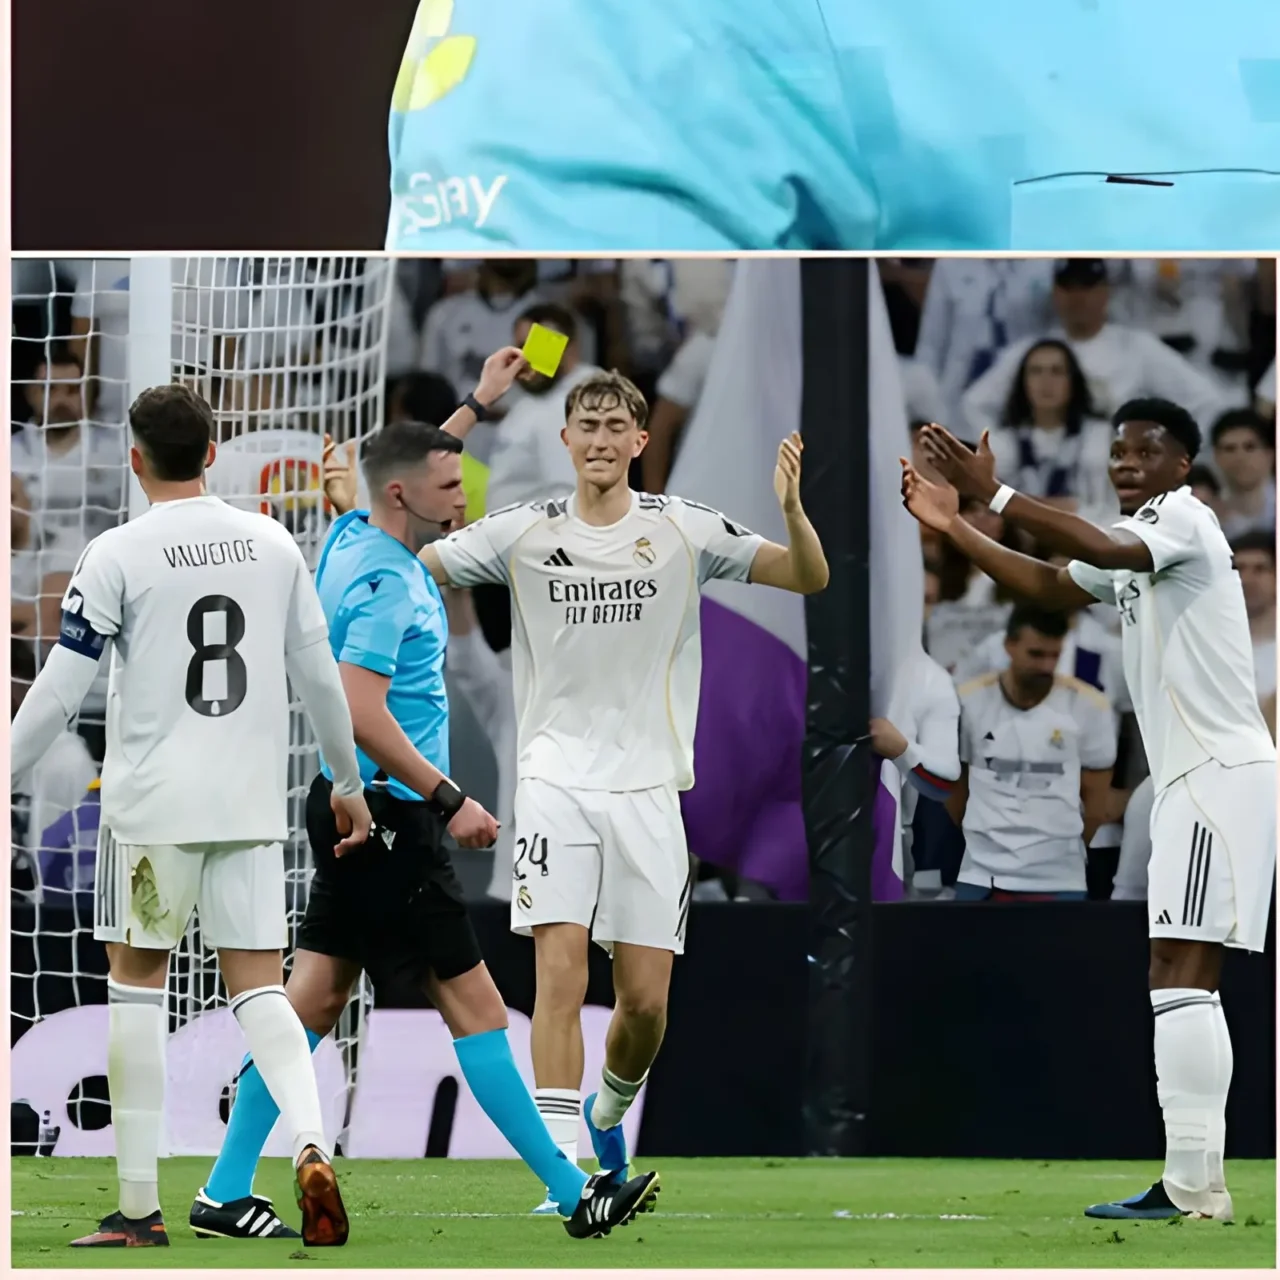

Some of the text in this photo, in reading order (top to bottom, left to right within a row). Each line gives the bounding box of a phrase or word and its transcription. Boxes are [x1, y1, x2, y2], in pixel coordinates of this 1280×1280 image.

[548, 577, 658, 602] Emirates
[185, 594, 248, 717] 8
[513, 833, 549, 881] 24
